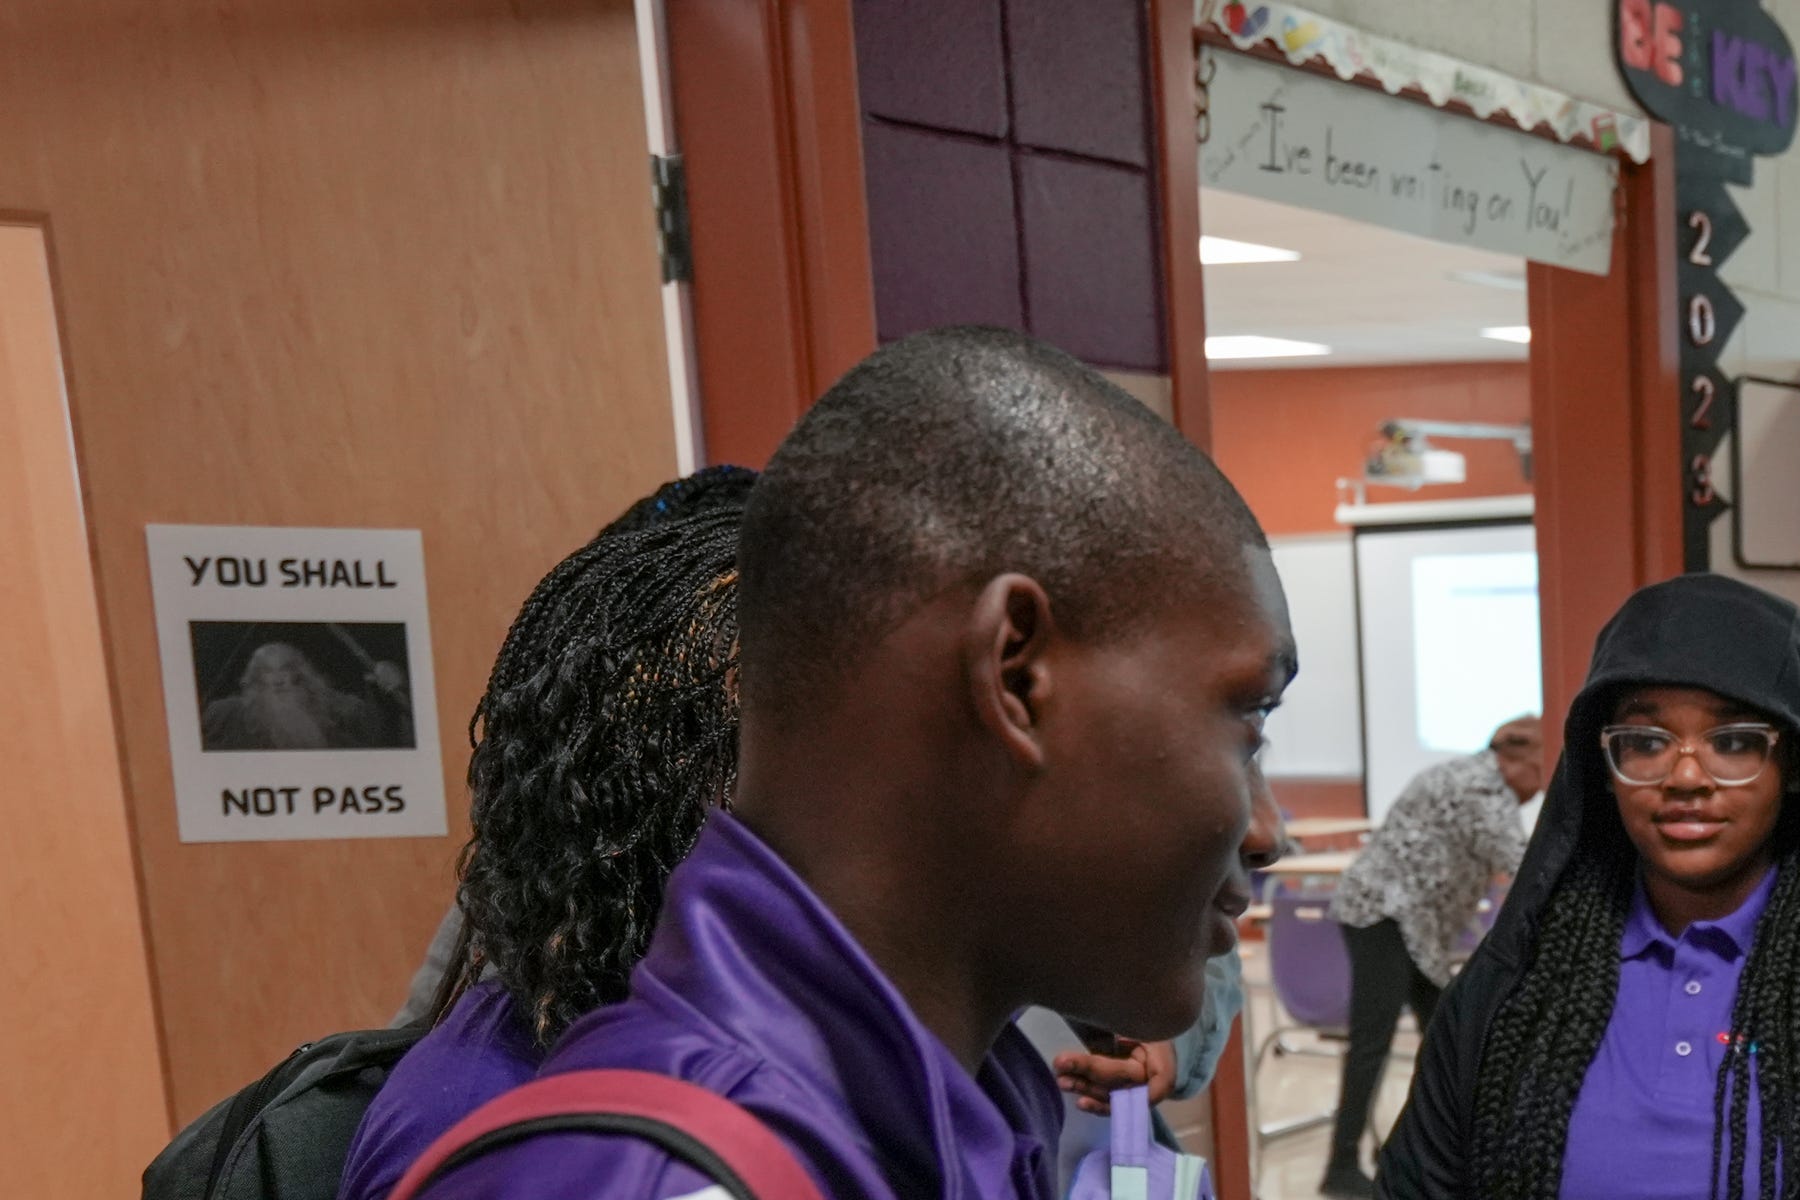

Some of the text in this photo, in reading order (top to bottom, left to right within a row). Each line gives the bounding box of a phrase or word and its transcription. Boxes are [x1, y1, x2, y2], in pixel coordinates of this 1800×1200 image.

[1620, 0, 1685, 87] BE
[1712, 28, 1795, 128] KEY
[1520, 157, 1574, 239] You!
[184, 556, 398, 588] YOU SHALL
[221, 784, 406, 817] NOT PASS
